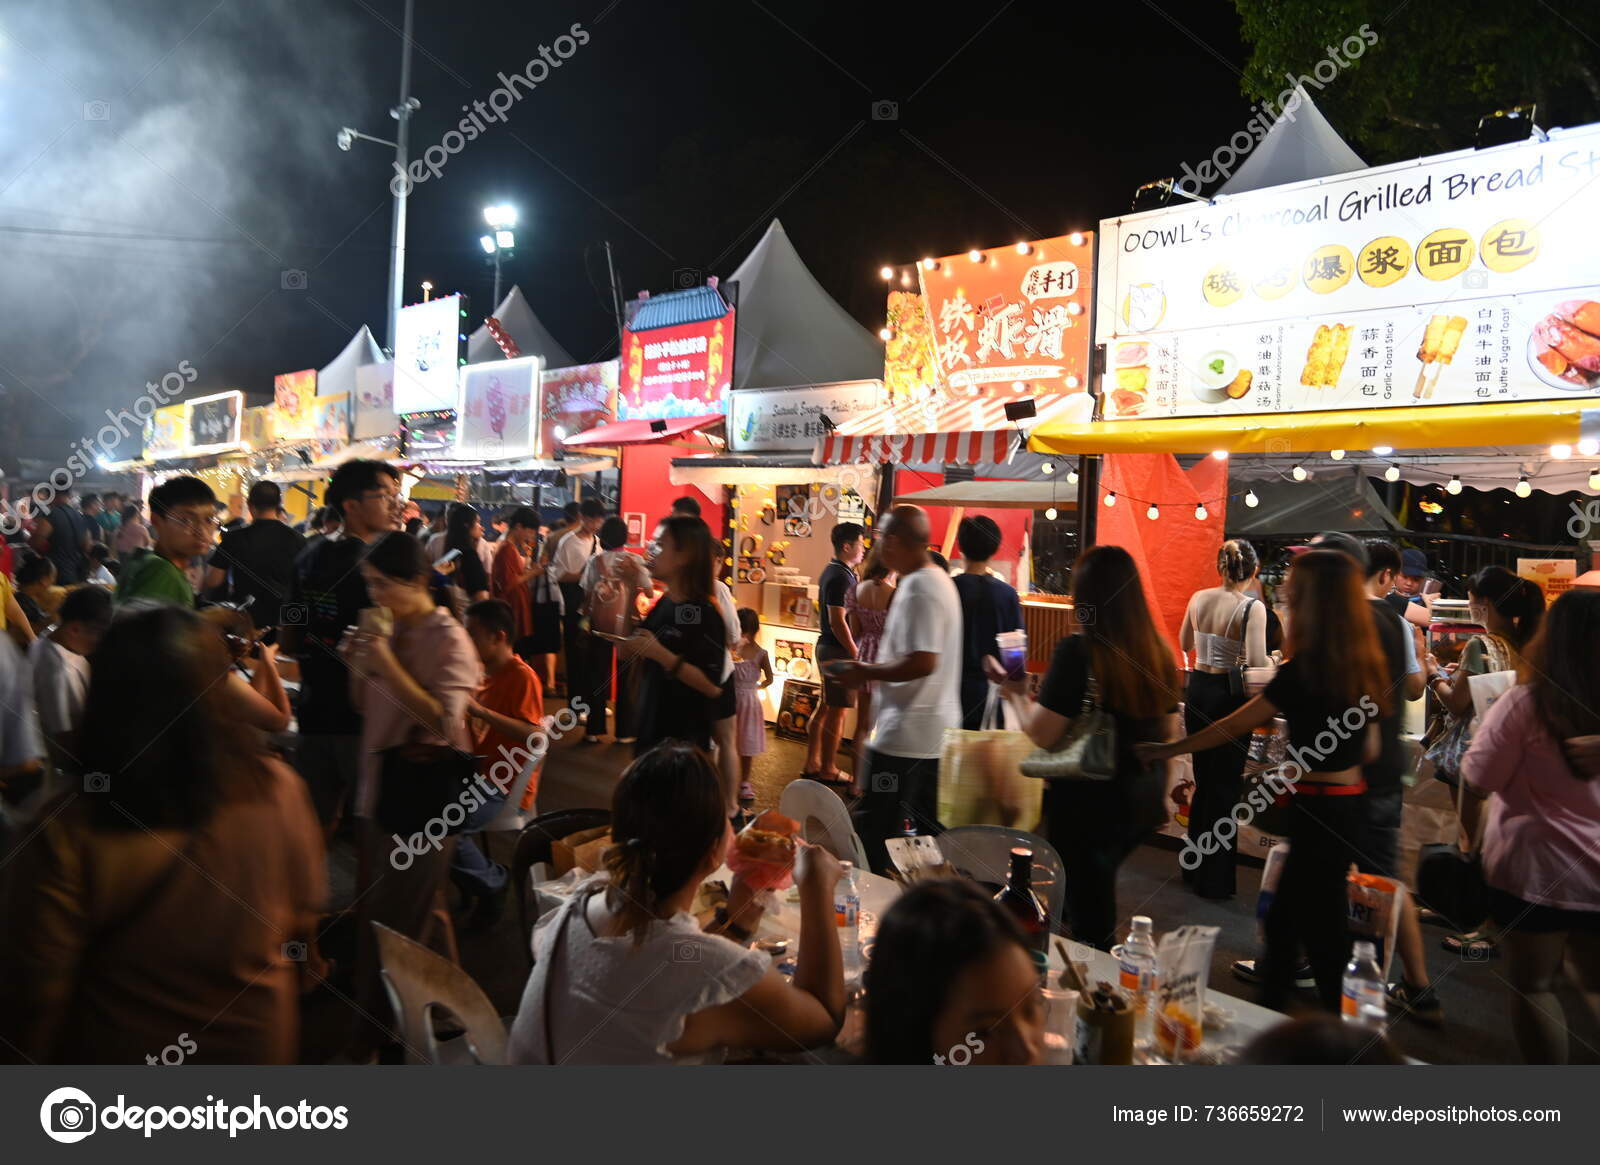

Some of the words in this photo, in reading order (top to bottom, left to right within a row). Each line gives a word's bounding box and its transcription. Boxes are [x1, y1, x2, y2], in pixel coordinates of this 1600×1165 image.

[1124, 220, 1212, 253] OOWL's
[1222, 195, 1329, 237] Chrcoal
[1338, 176, 1432, 222] Grilled
[1442, 155, 1544, 200] Bread
[1039, 269, 1076, 293] 手打
[1385, 320, 1394, 345] Stick
[1500, 308, 1510, 335] Toast
[1360, 327, 1380, 397] 蒜香面包
[1385, 346, 1393, 368] Toast
[1474, 307, 1494, 398] 白糖牛油面包
[1500, 336, 1511, 363] Sugar
[1384, 369, 1393, 400] Garlic
[1498, 367, 1509, 394] Butter
